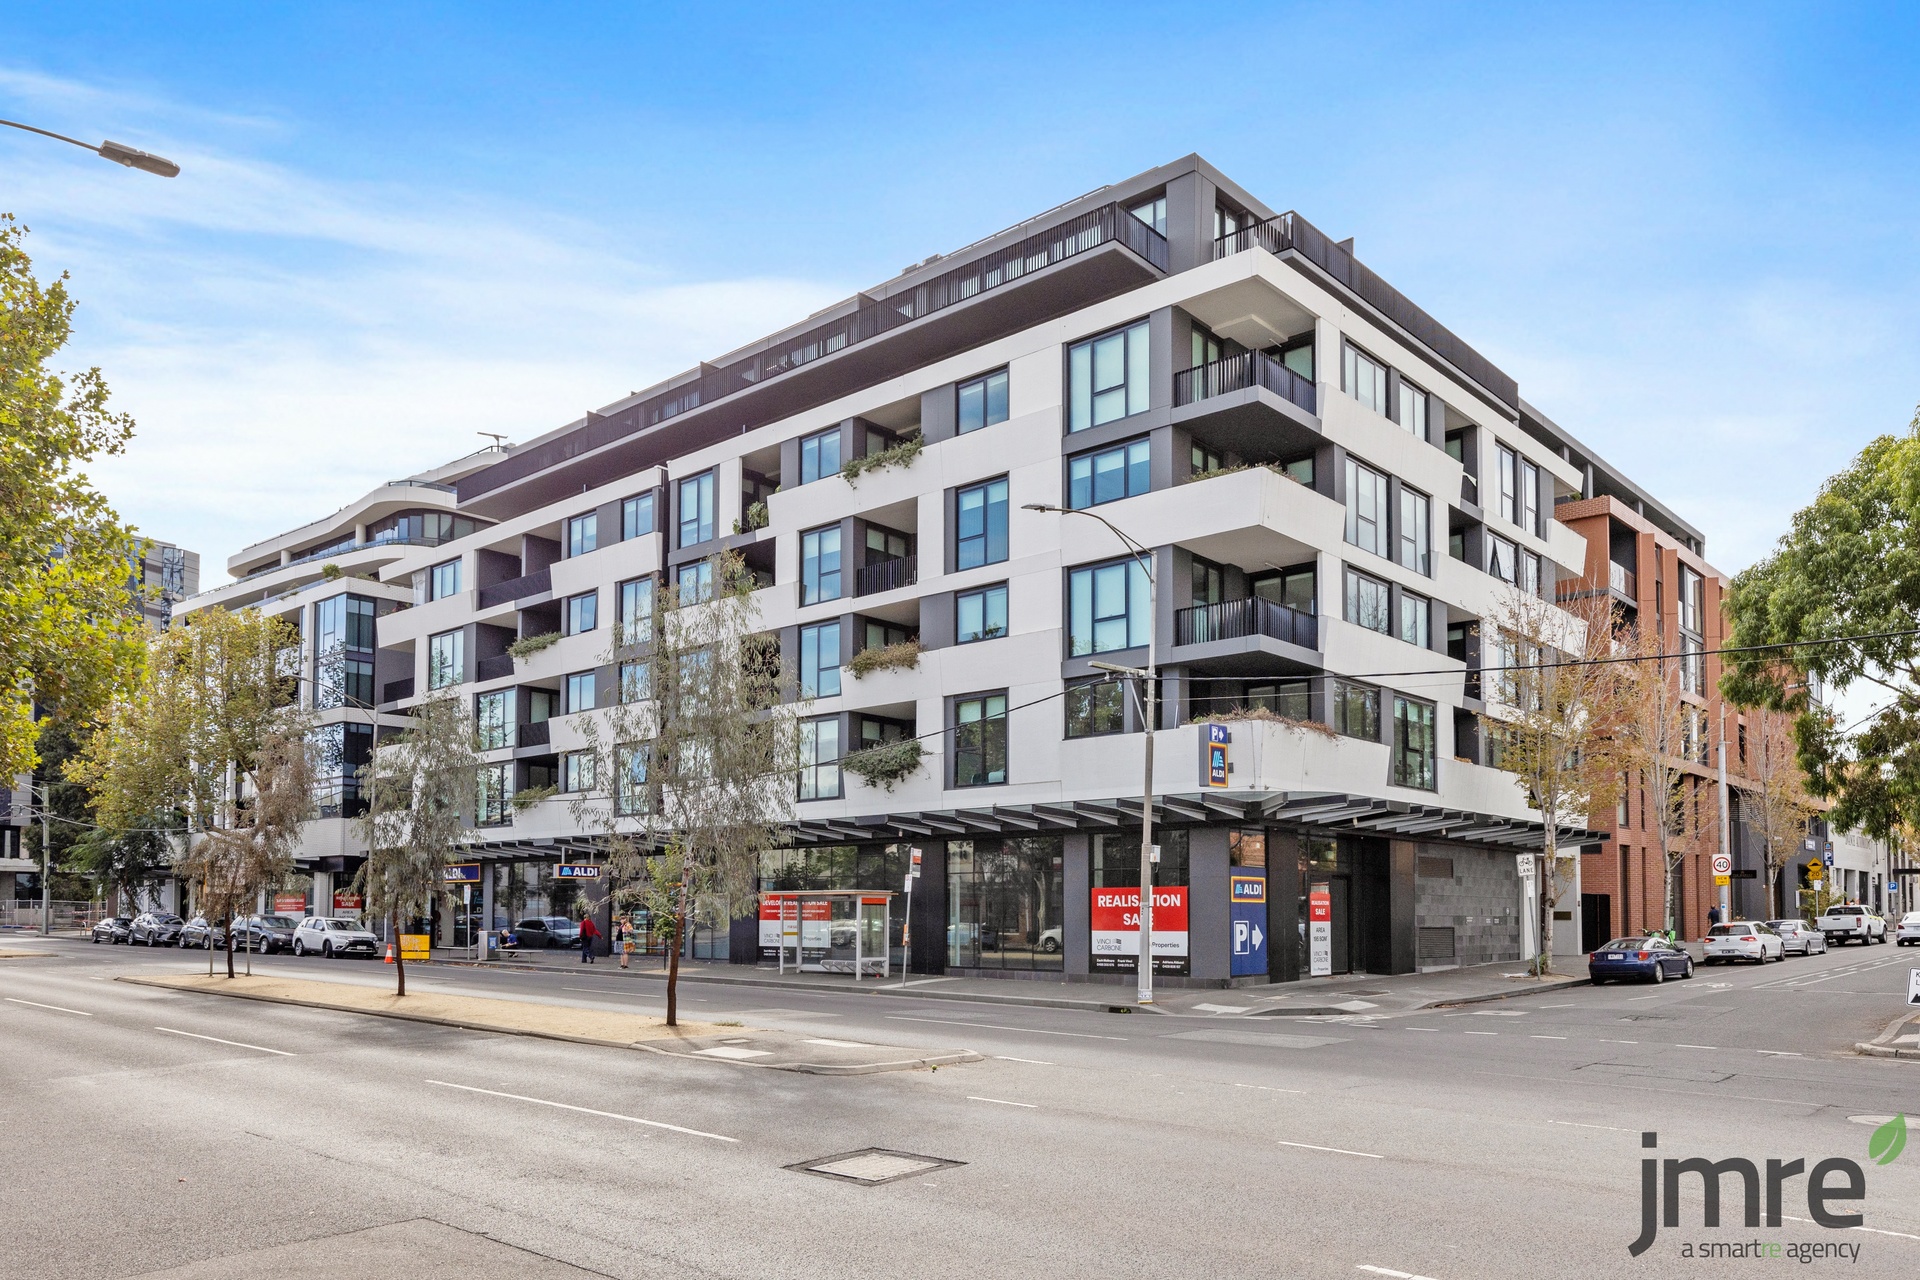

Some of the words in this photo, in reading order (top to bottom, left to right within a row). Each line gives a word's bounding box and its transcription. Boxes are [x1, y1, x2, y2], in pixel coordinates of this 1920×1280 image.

[1212, 769, 1224, 778] ALDI
[573, 867, 598, 876] ALDI
[1244, 884, 1262, 894] ALDI
[1098, 894, 1180, 907] REALISTION
[1236, 924, 1248, 952] P
